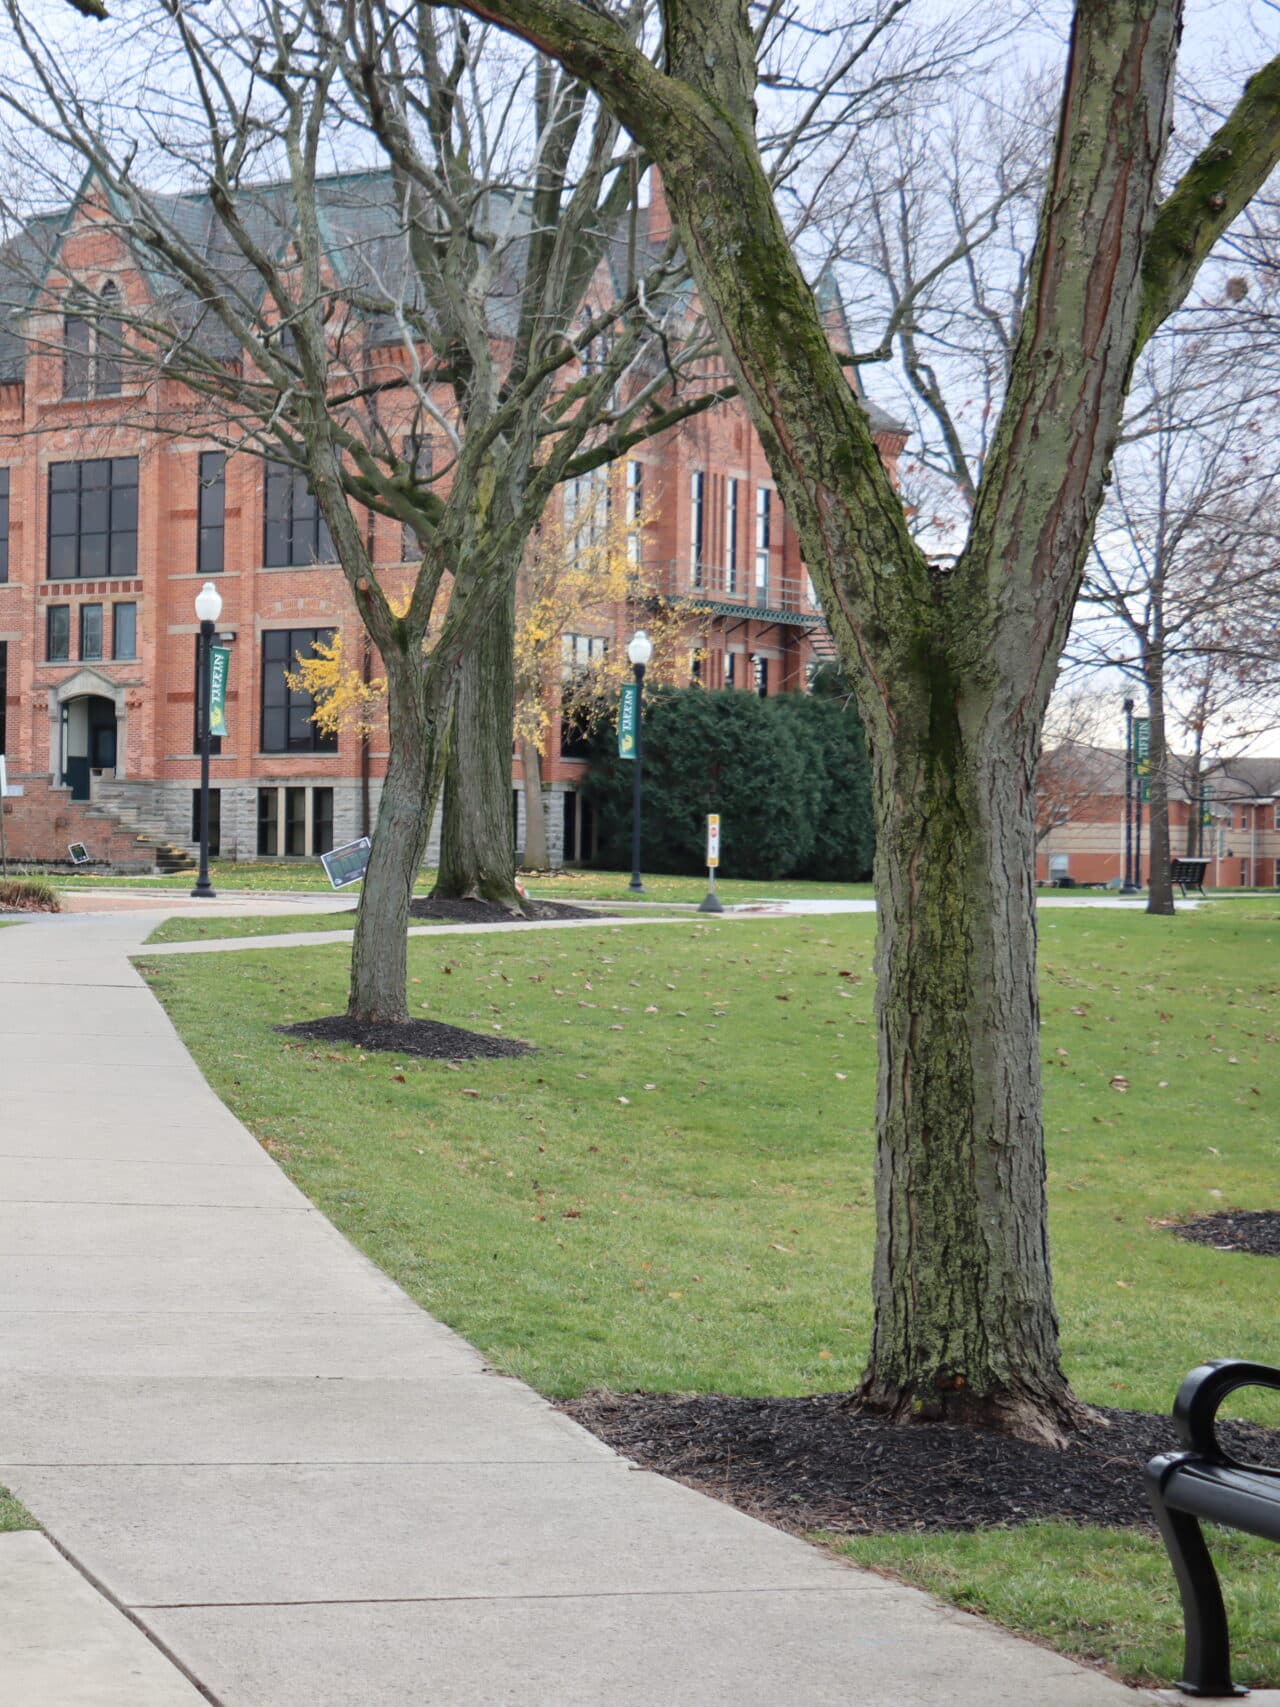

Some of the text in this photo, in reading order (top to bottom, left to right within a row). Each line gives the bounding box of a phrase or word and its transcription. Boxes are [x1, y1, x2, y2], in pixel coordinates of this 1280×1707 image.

[211, 653, 223, 704] TIFFIN
[622, 690, 631, 732] TIFFIN
[1138, 721, 1148, 758] TIFFIN
